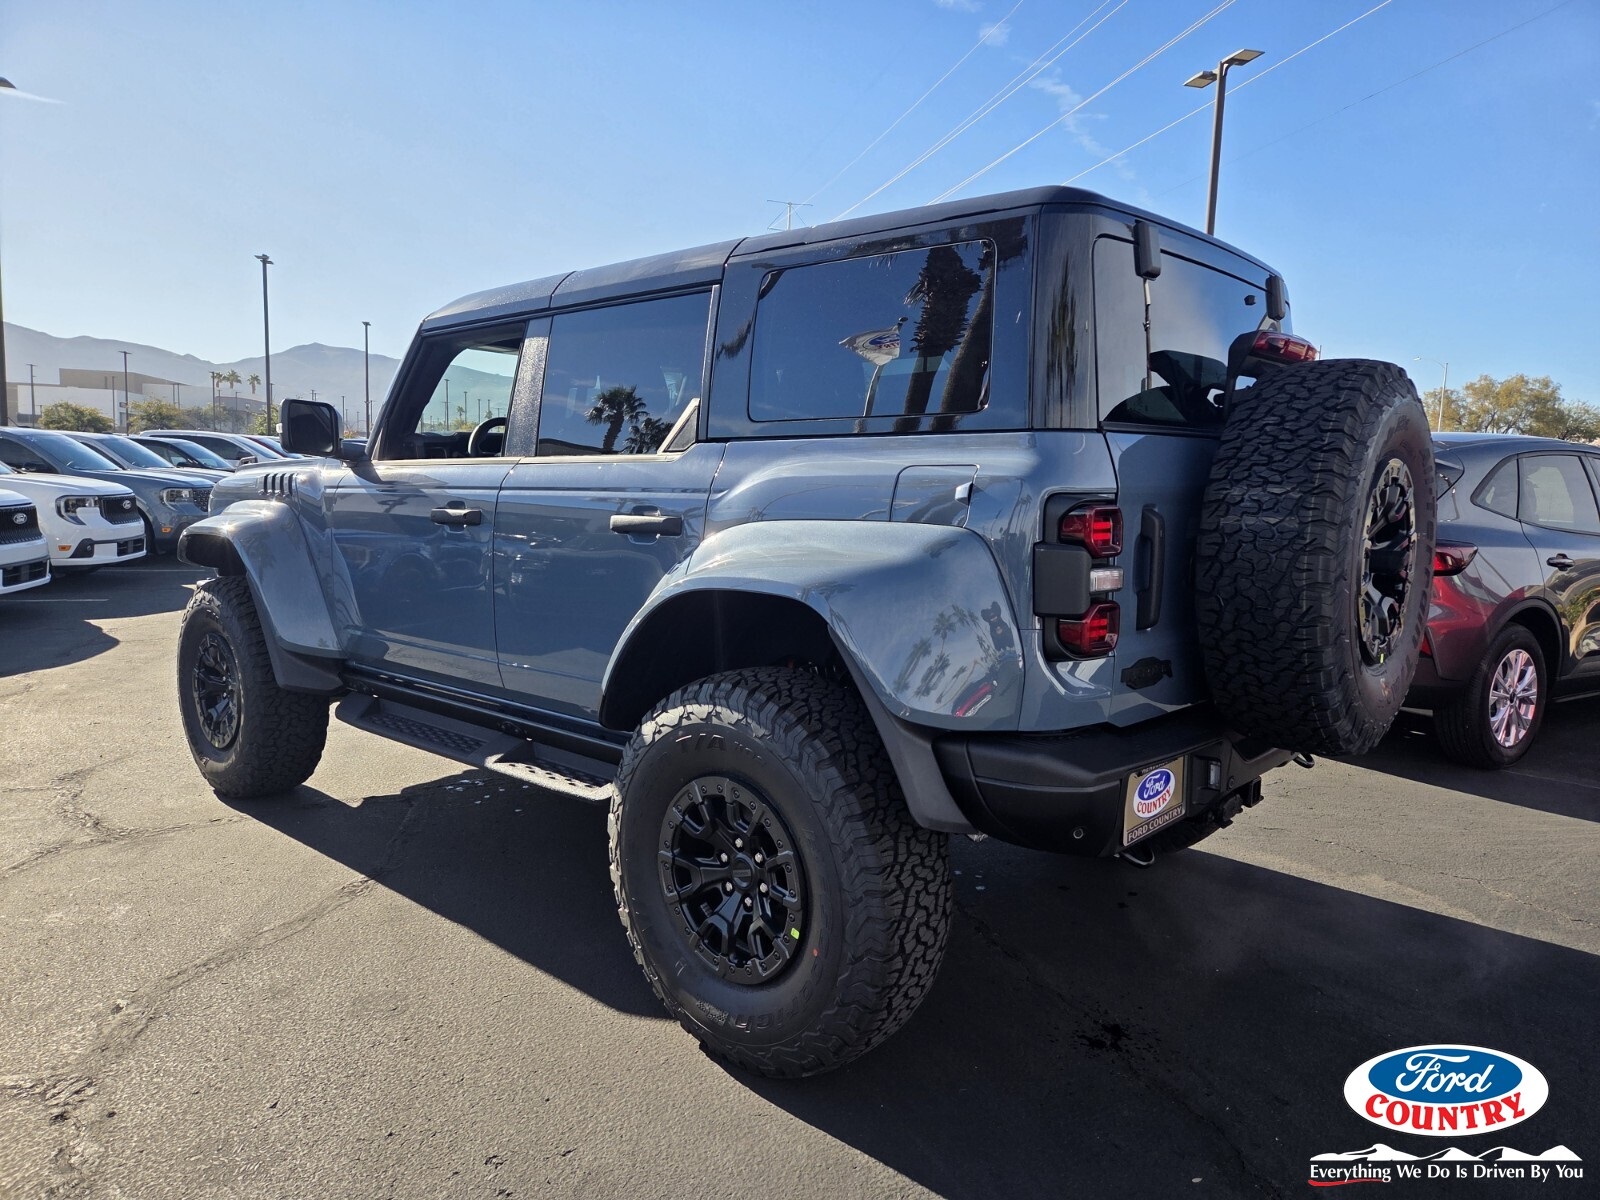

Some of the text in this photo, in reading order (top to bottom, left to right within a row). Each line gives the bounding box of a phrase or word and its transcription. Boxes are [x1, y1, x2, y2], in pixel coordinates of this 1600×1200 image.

[1137, 786, 1171, 814] COUNTRY
[1144, 773, 1166, 799] Ford
[1128, 806, 1182, 842] FORD COUNTRY
